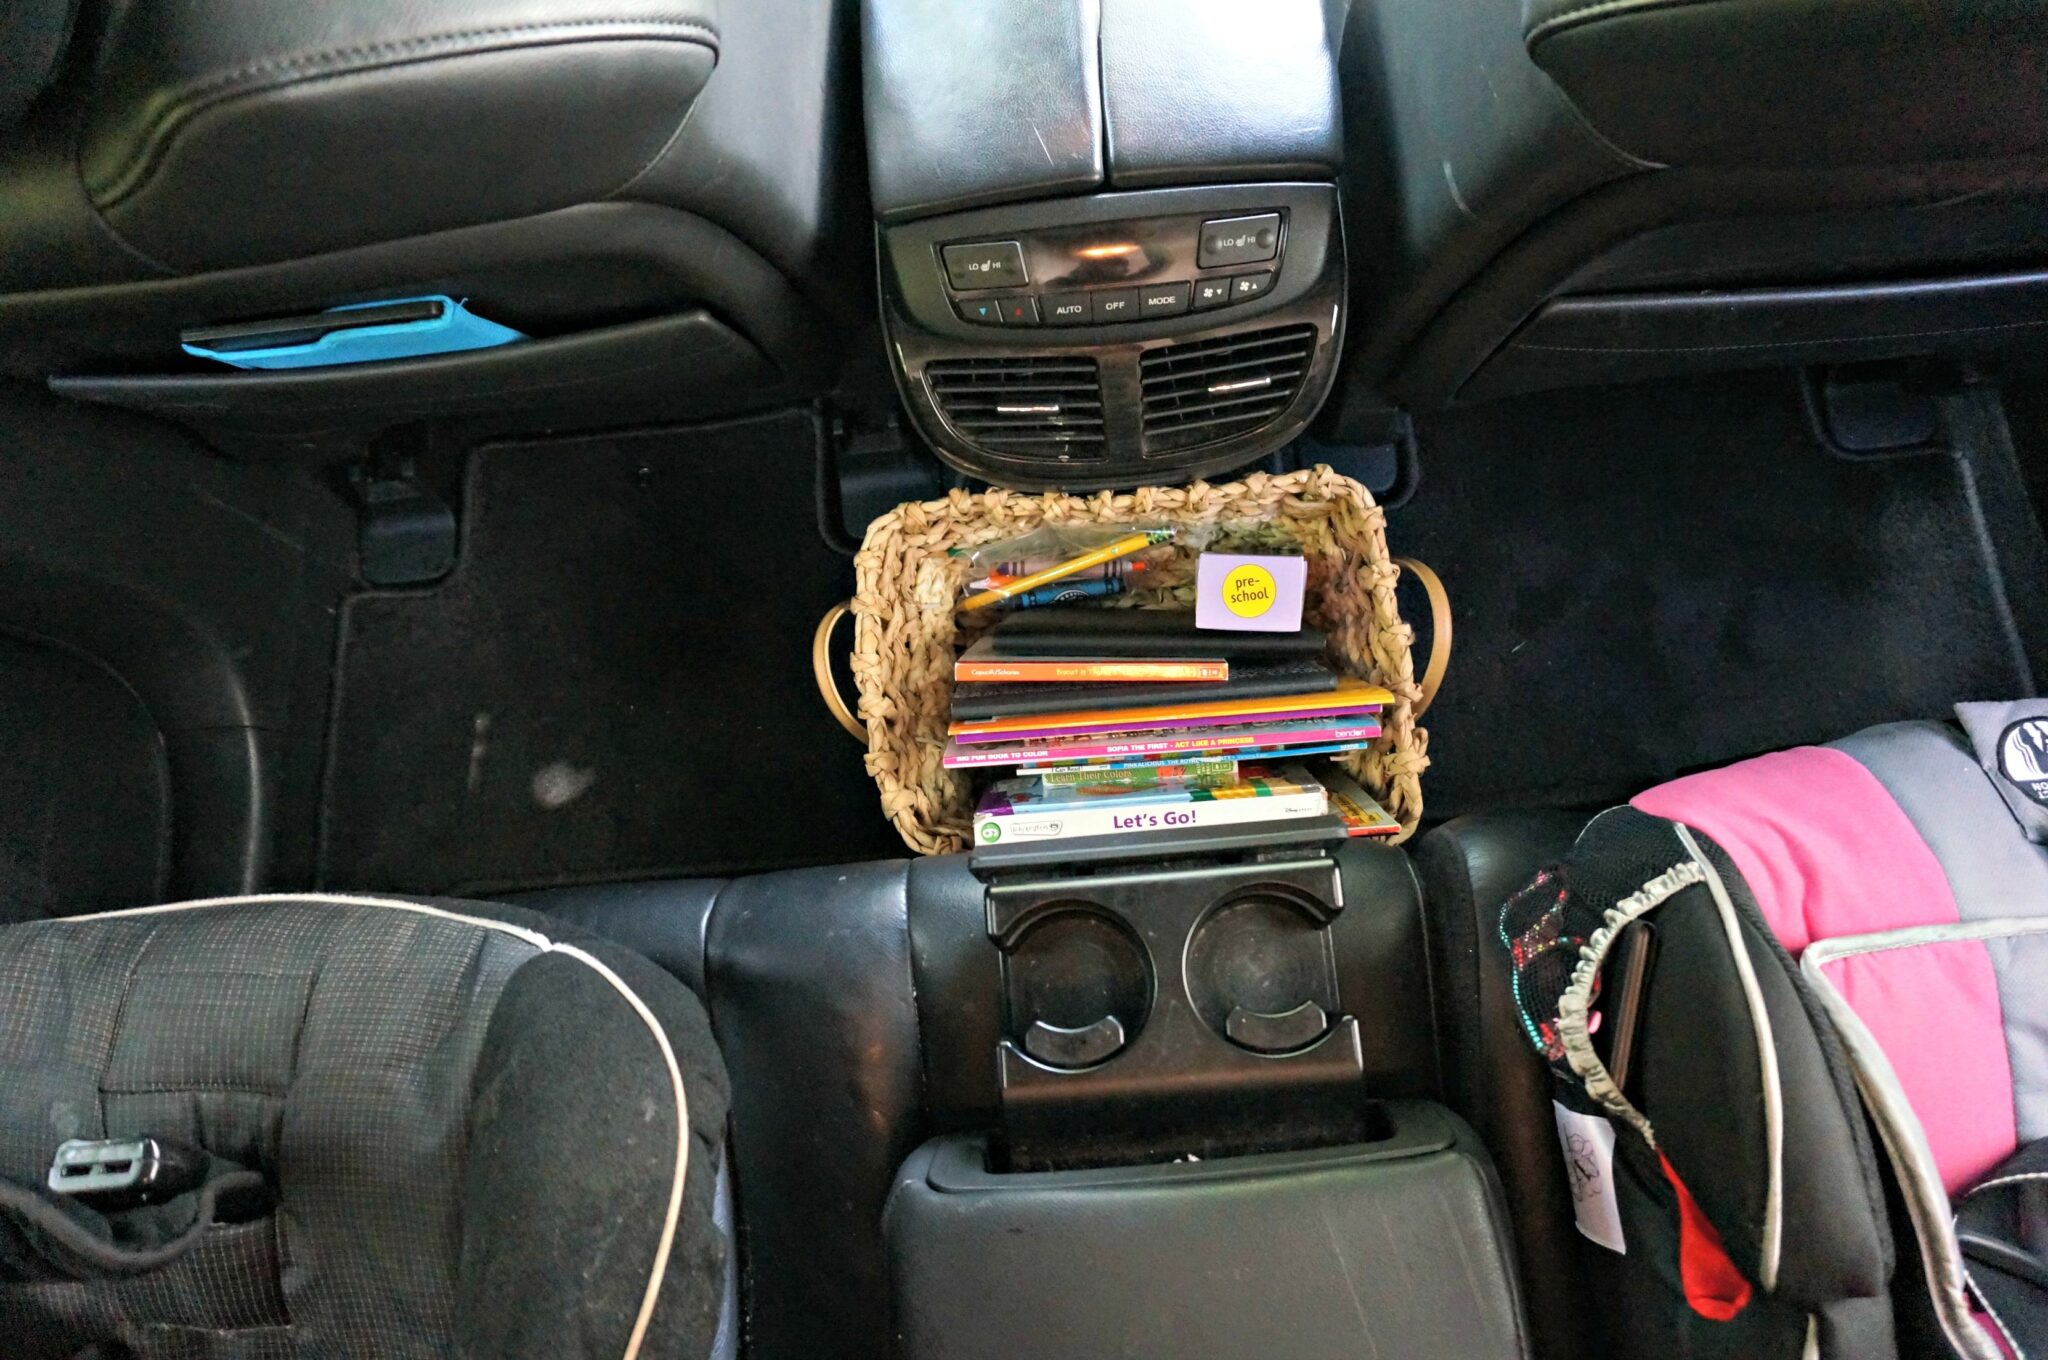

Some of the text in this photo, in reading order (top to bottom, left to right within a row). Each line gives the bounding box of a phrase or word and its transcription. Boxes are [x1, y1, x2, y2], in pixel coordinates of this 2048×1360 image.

[1223, 236, 1256, 247] LO HI
[968, 263, 979, 271] LO
[1105, 301, 1126, 311] OFF
[1148, 296, 1176, 306] MODE
[1056, 305, 1082, 315] AUTO
[1235, 577, 1260, 591] pre-
[1230, 586, 1269, 603] school
[1335, 729, 1366, 738] bendon
[1106, 745, 1129, 753] SOFIA
[1147, 742, 1168, 750] FIRST
[1175, 741, 1190, 749] ACT
[1192, 739, 1209, 747] LIKE
[1218, 736, 1255, 745] PRINCESS
[1022, 750, 1049, 758] COLOR
[1051, 769, 1133, 783] Learn Their Colors
[1163, 810, 1197, 826] Go!
